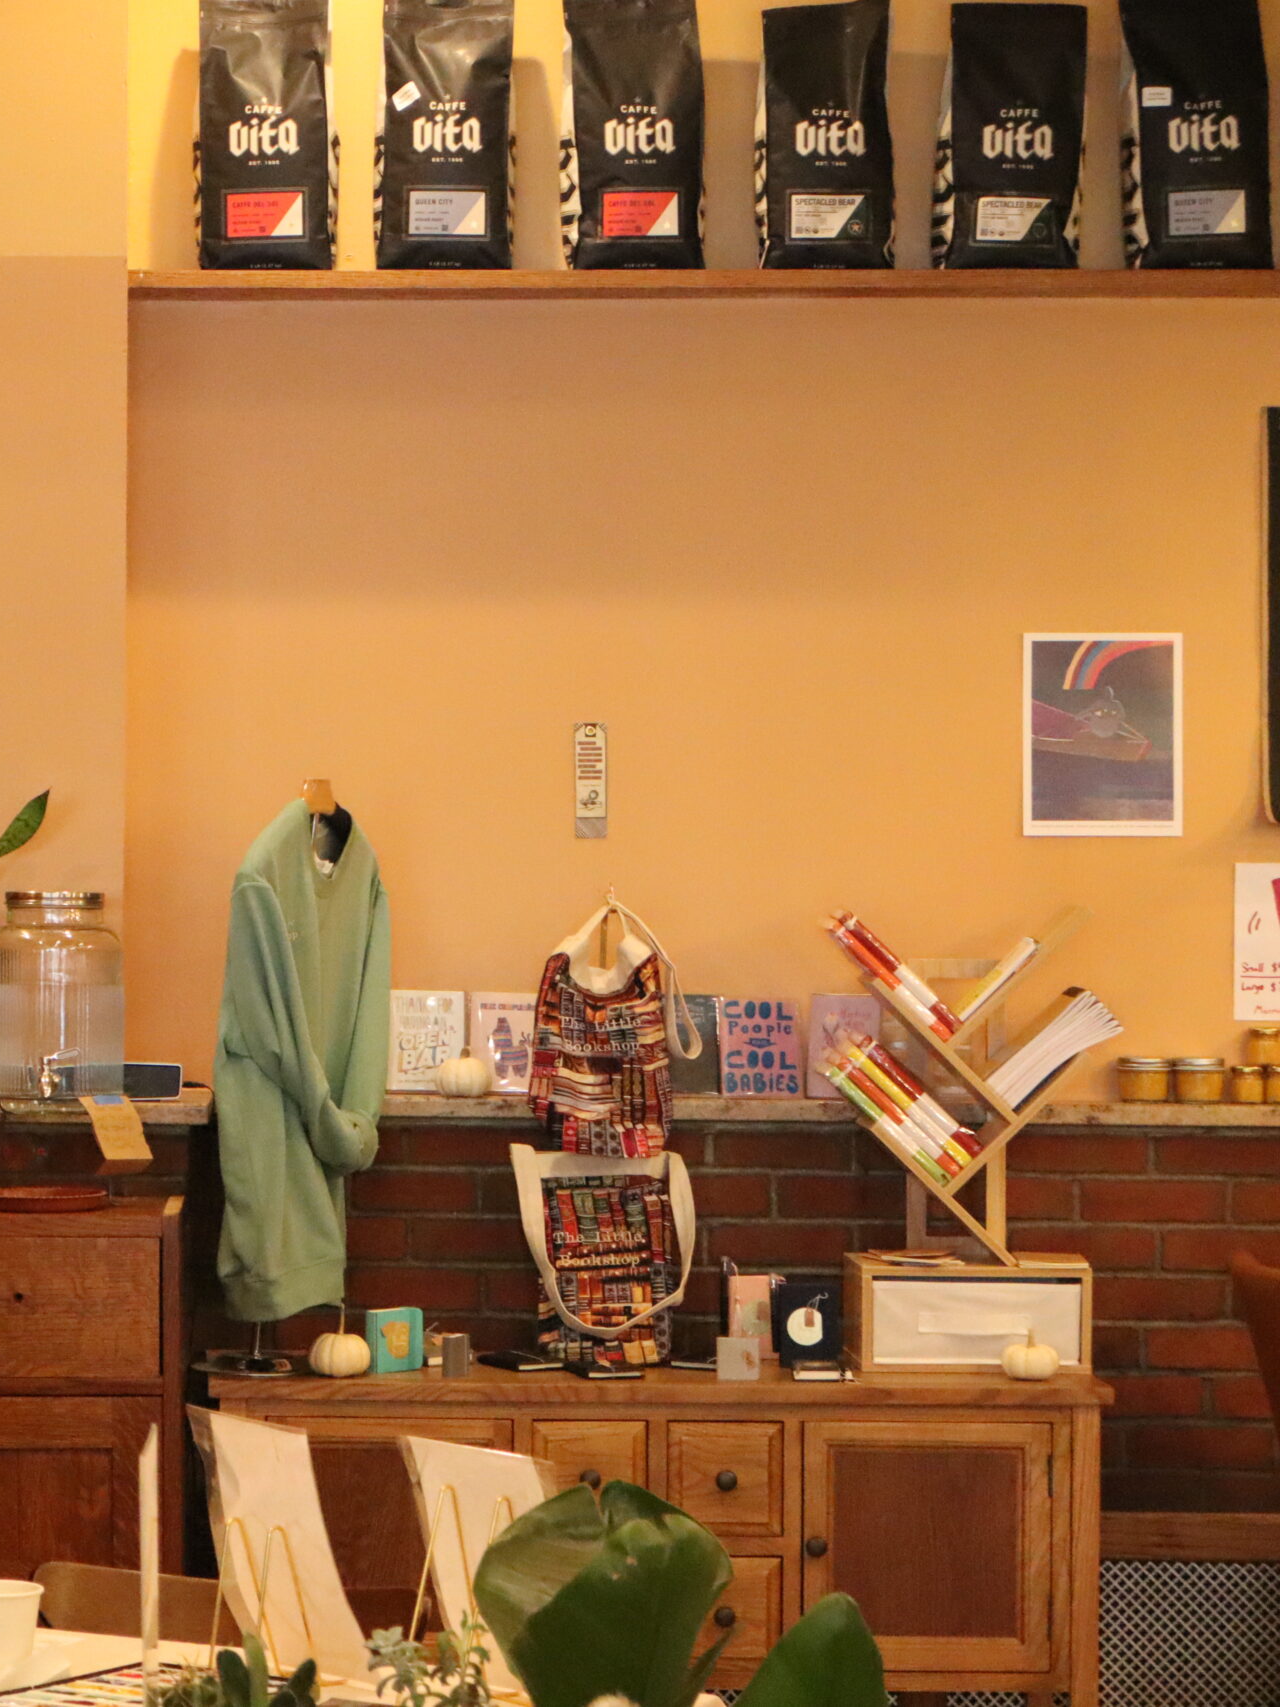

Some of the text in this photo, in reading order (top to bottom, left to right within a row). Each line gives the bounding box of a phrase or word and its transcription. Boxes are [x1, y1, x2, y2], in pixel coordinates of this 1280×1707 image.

[245, 105, 282, 114] CAFFE
[429, 101, 466, 111] CAFFE
[620, 105, 658, 115] CAFFE
[1184, 100, 1222, 111] CAFFE
[812, 108, 851, 119] CAFFE
[1000, 108, 1039, 118] CAFFE
[794, 198, 856, 206] SPECTACLED BEAR
[724, 1001, 793, 1021] COOL
[560, 1016, 641, 1032] The Little
[728, 1021, 793, 1037] People
[399, 1031, 450, 1050] OPEN
[565, 1041, 640, 1055] Bookshop
[725, 1050, 797, 1070] COOL
[553, 1231, 642, 1243] The Little
[560, 1253, 640, 1269] Bookshop
